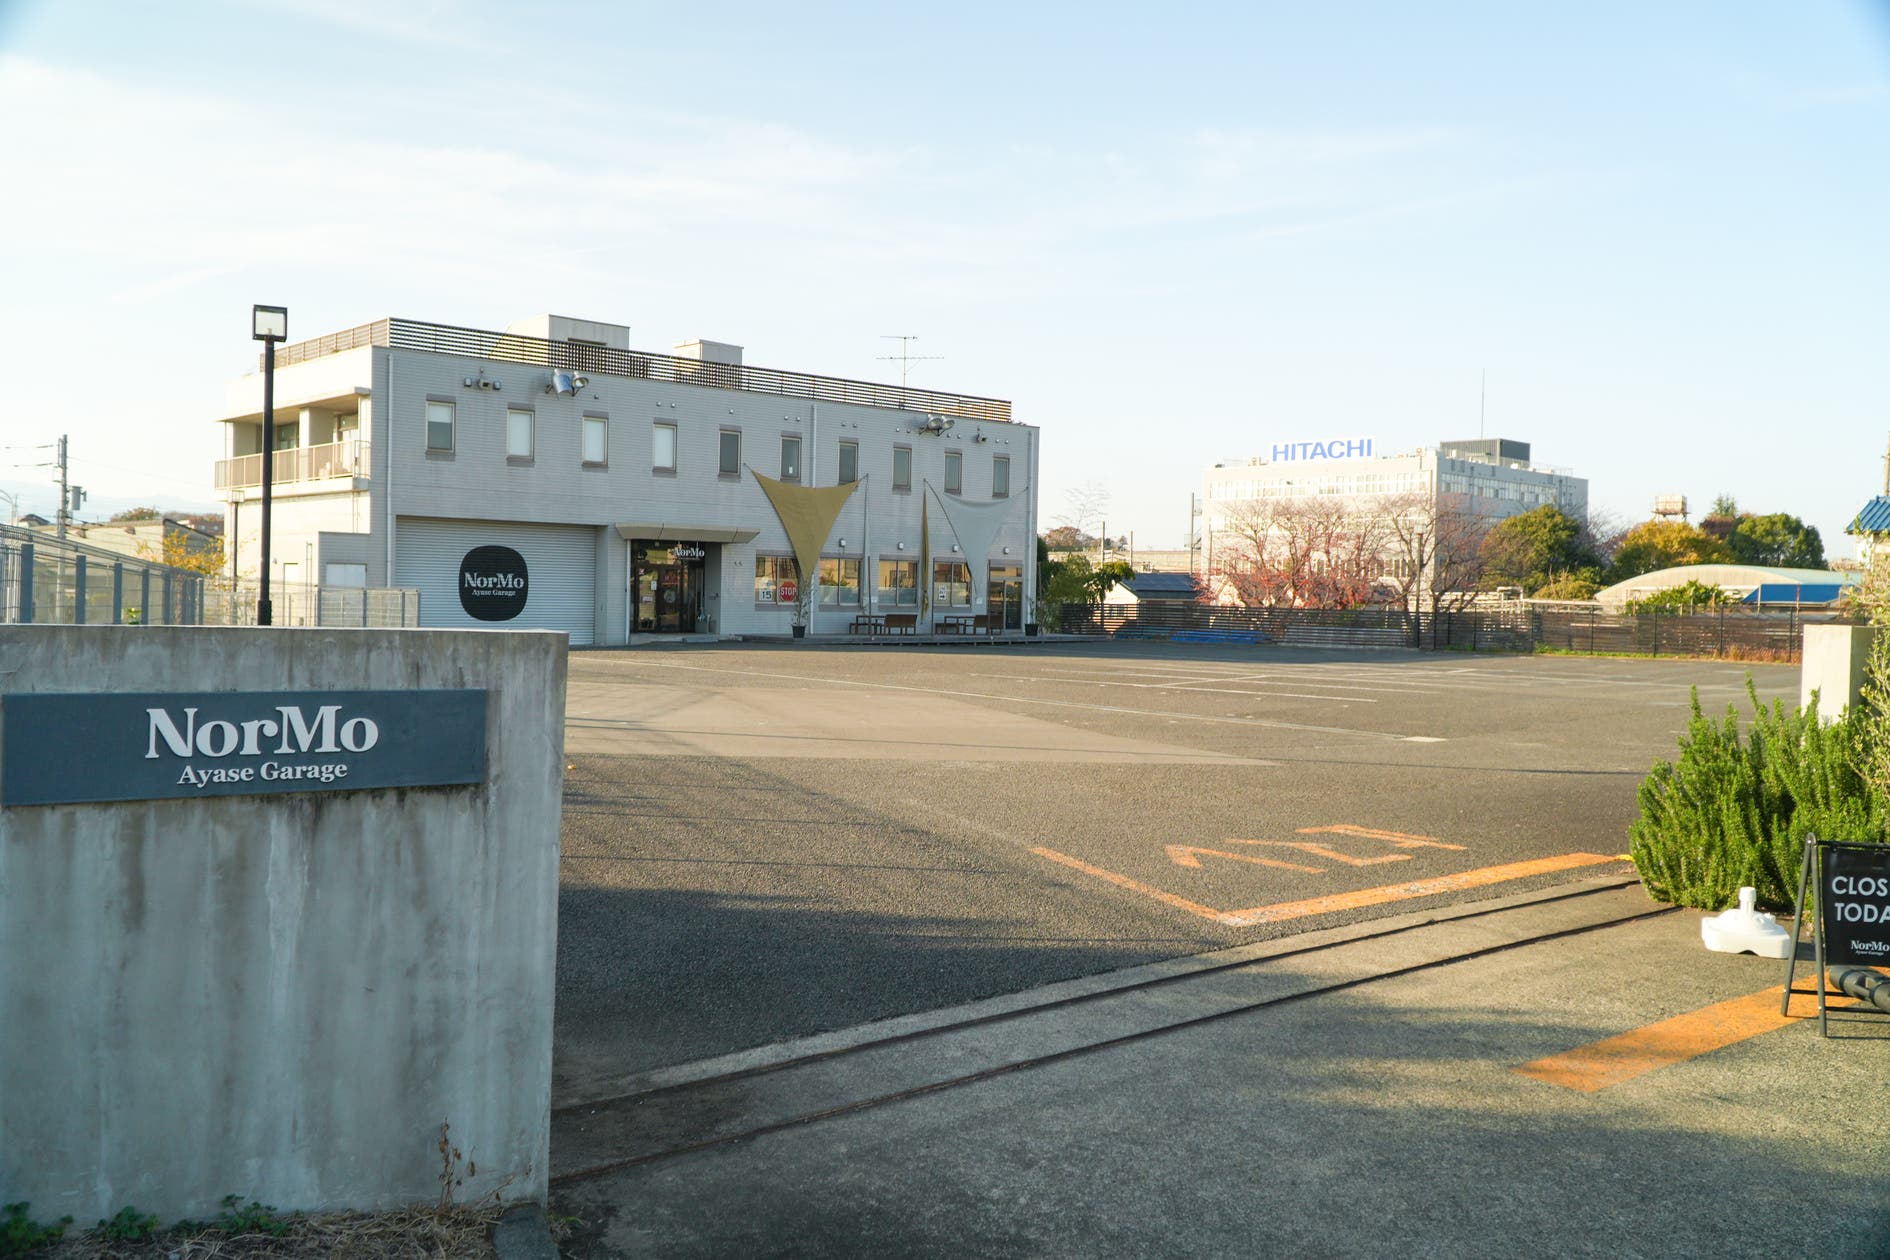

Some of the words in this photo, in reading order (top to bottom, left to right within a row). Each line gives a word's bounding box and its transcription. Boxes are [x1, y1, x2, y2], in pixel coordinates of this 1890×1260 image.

[1272, 439, 1372, 461] HITACHI
[464, 572, 525, 589] NorMo
[780, 587, 797, 596] STOP
[762, 591, 772, 599] 15
[145, 705, 379, 759] NorMo
[177, 764, 255, 788] Ayase
[260, 761, 348, 782] Garage
[1831, 875, 1889, 897] CLOS
[1834, 902, 1890, 924] TODA
[1850, 940, 1890, 952] NorMo
